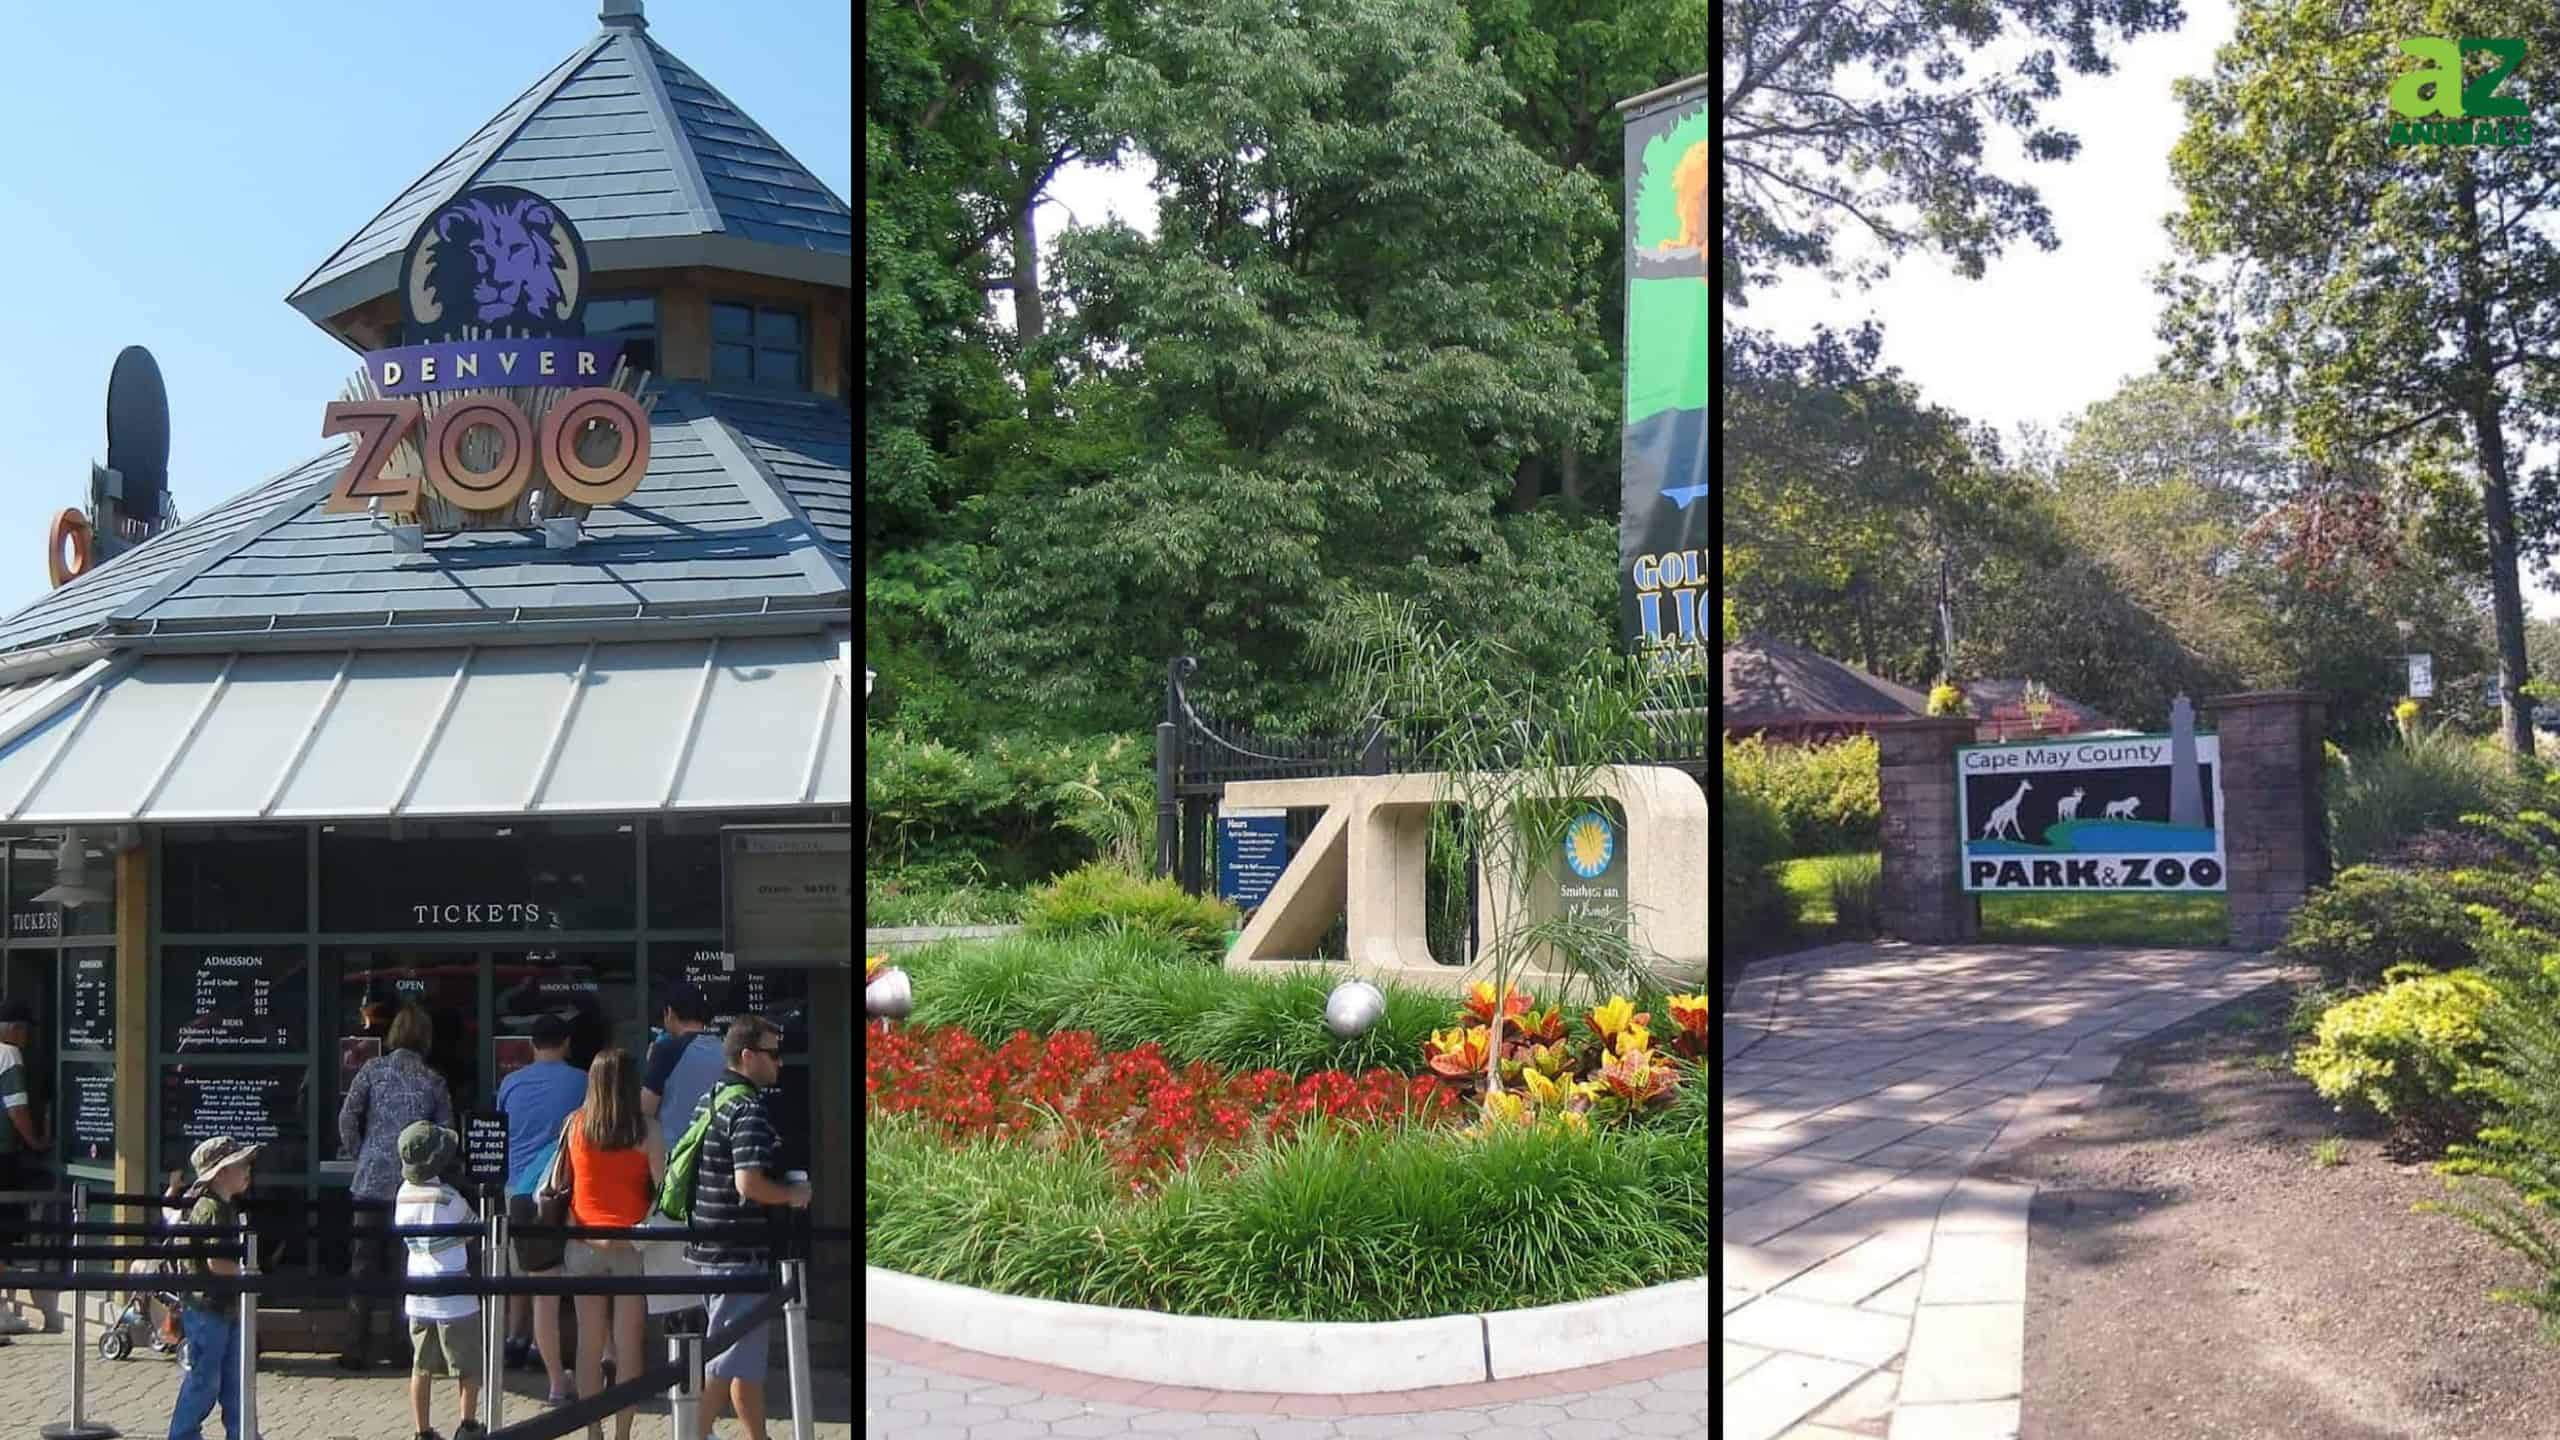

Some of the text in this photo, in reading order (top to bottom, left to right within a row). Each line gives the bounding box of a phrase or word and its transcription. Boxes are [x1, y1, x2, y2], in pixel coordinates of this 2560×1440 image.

[383, 351, 597, 386] DENVER
[322, 387, 650, 514] ZOO
[1633, 550, 1708, 591] GOL
[1965, 745, 2163, 769] Cape May County
[1224, 764, 1708, 990] ZOO
[1969, 858, 2099, 888] PARK
[2120, 858, 2223, 887] ZOO
[413, 904, 541, 924] TICKETS
[13, 911, 58, 931] TICKETS
[204, 956, 263, 967] ADMISSION
[694, 952, 724, 961] ADMI
[196, 970, 211, 979] Age
[395, 980, 425, 992] OPEN
[473, 1118, 501, 1129] Please
[467, 1129, 506, 1138] wait here
[470, 1140, 504, 1149] for next
[470, 1151, 504, 1160] available
[471, 1163, 502, 1173] cashier
